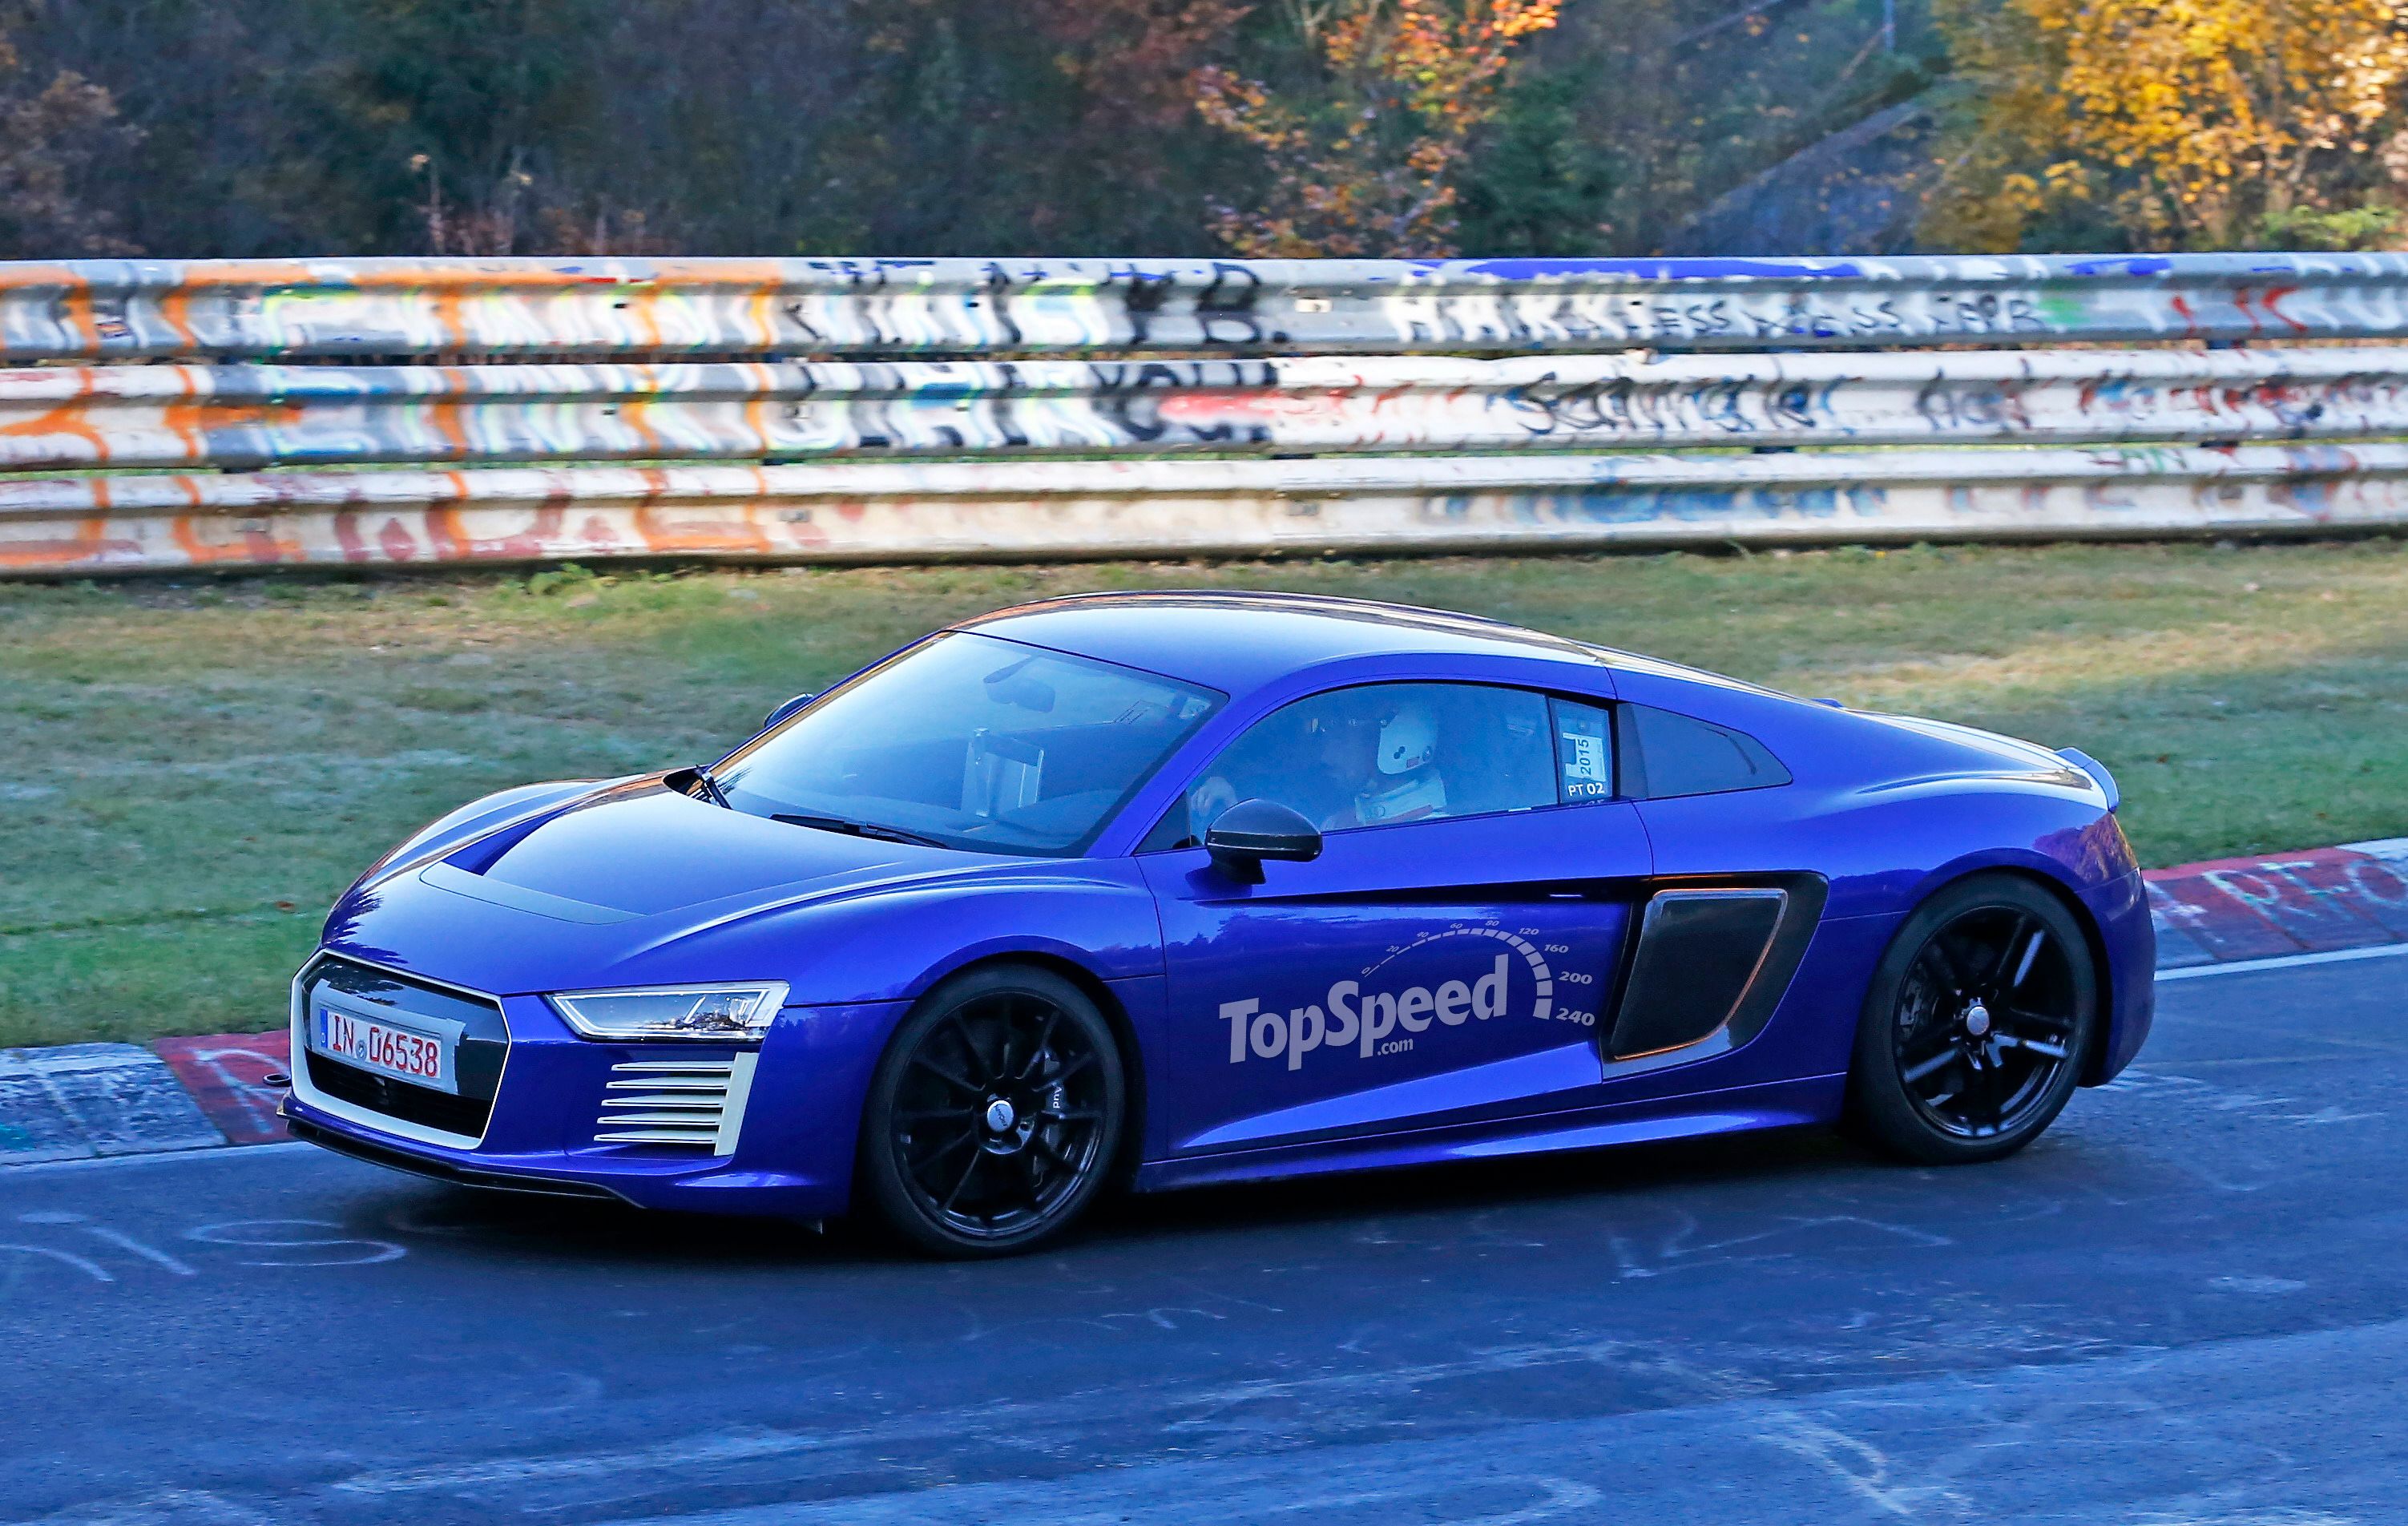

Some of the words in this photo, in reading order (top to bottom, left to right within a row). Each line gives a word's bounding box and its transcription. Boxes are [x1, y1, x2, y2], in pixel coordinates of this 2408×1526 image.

[1578, 739, 1591, 775] 2015
[1567, 784, 1583, 797] PT
[333, 1015, 353, 1055] IN
